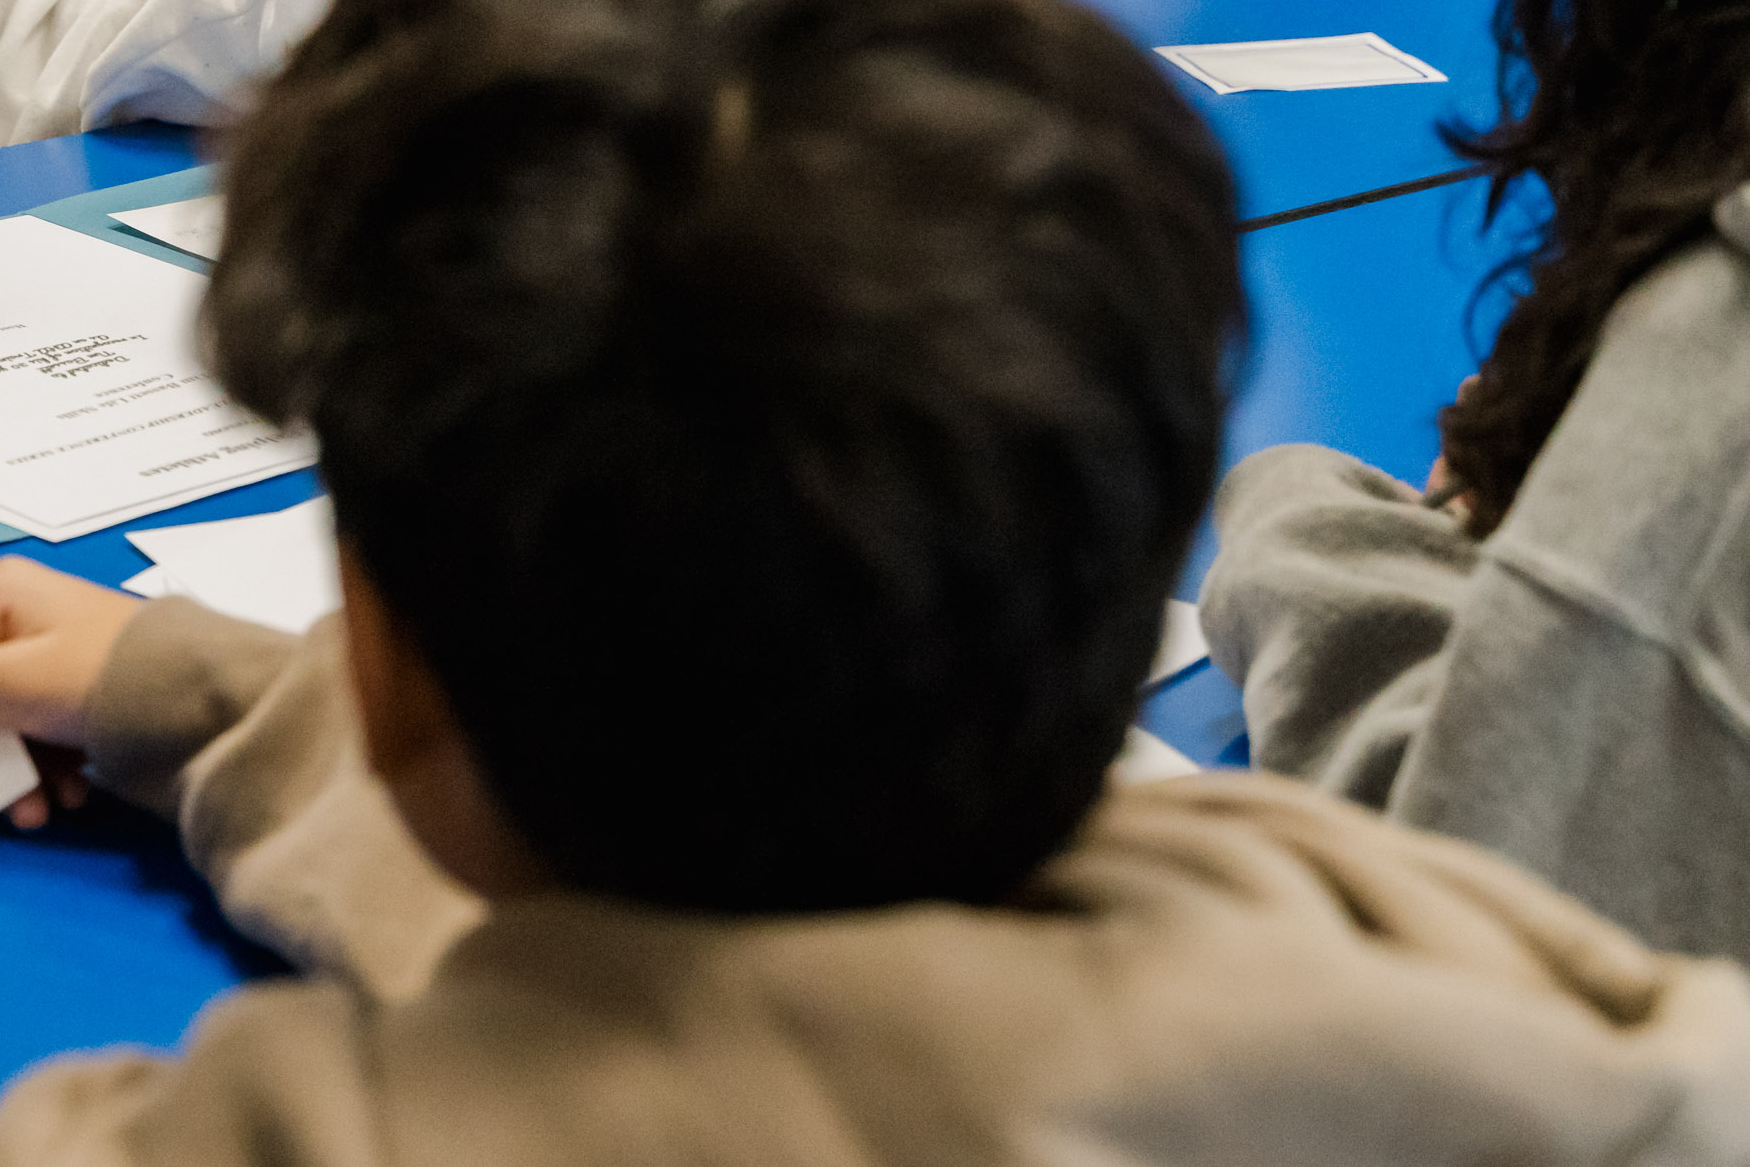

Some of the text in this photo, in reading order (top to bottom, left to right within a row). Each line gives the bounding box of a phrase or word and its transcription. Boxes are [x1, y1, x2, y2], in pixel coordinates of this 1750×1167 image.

[94, 373, 174, 399] Conference
[54, 405, 99, 419] Skills
[5, 399, 229, 466] LEADERSHIP CONFERENCE SERIES
[138, 452, 221, 477] Athletes
